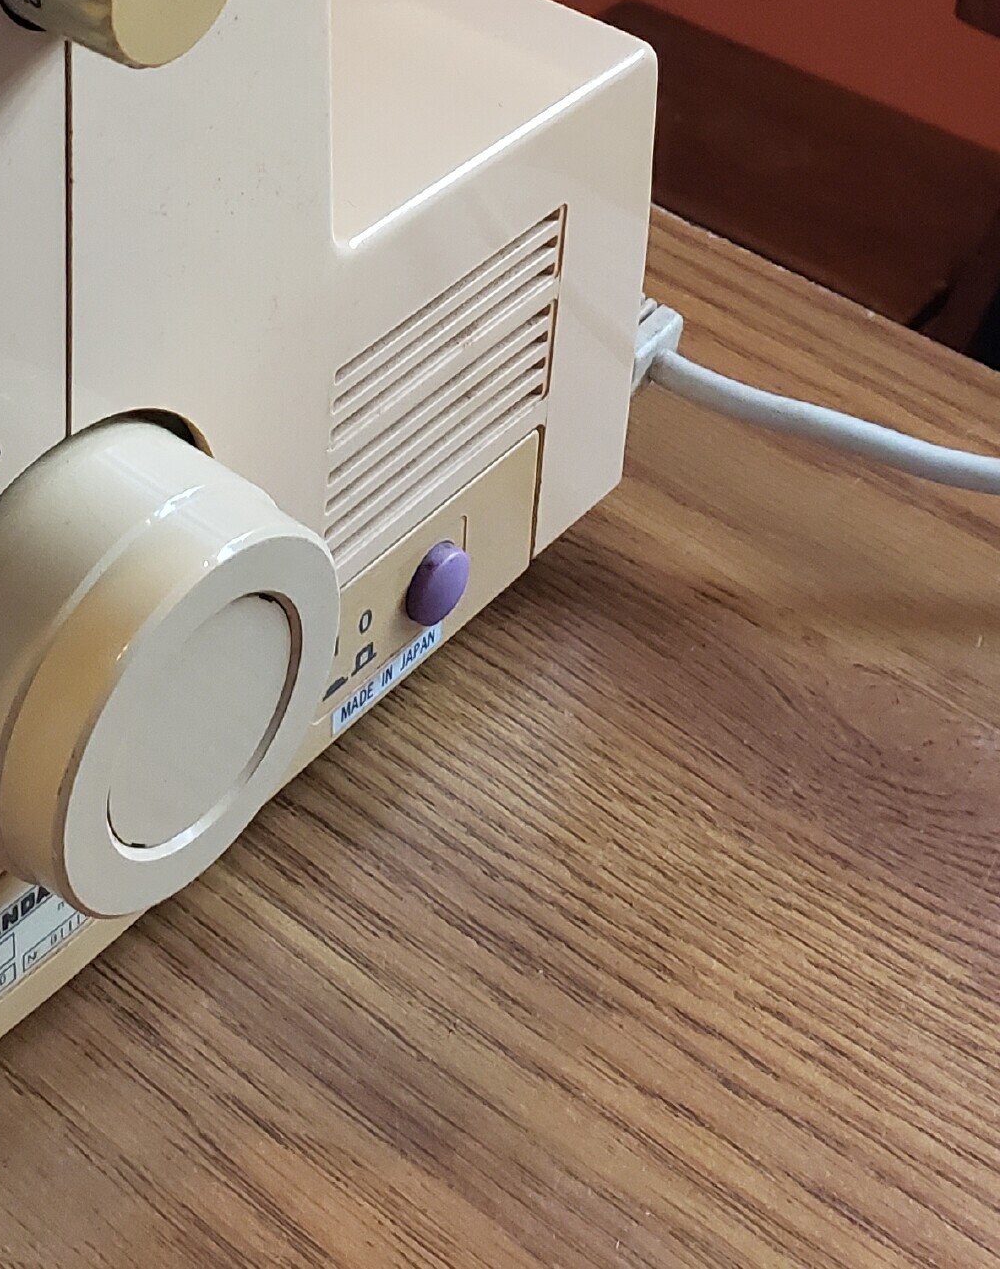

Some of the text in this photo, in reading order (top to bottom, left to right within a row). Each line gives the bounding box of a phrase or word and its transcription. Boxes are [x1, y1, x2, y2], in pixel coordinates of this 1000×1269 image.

[341, 629, 436, 723] MADE IN JAPAN
